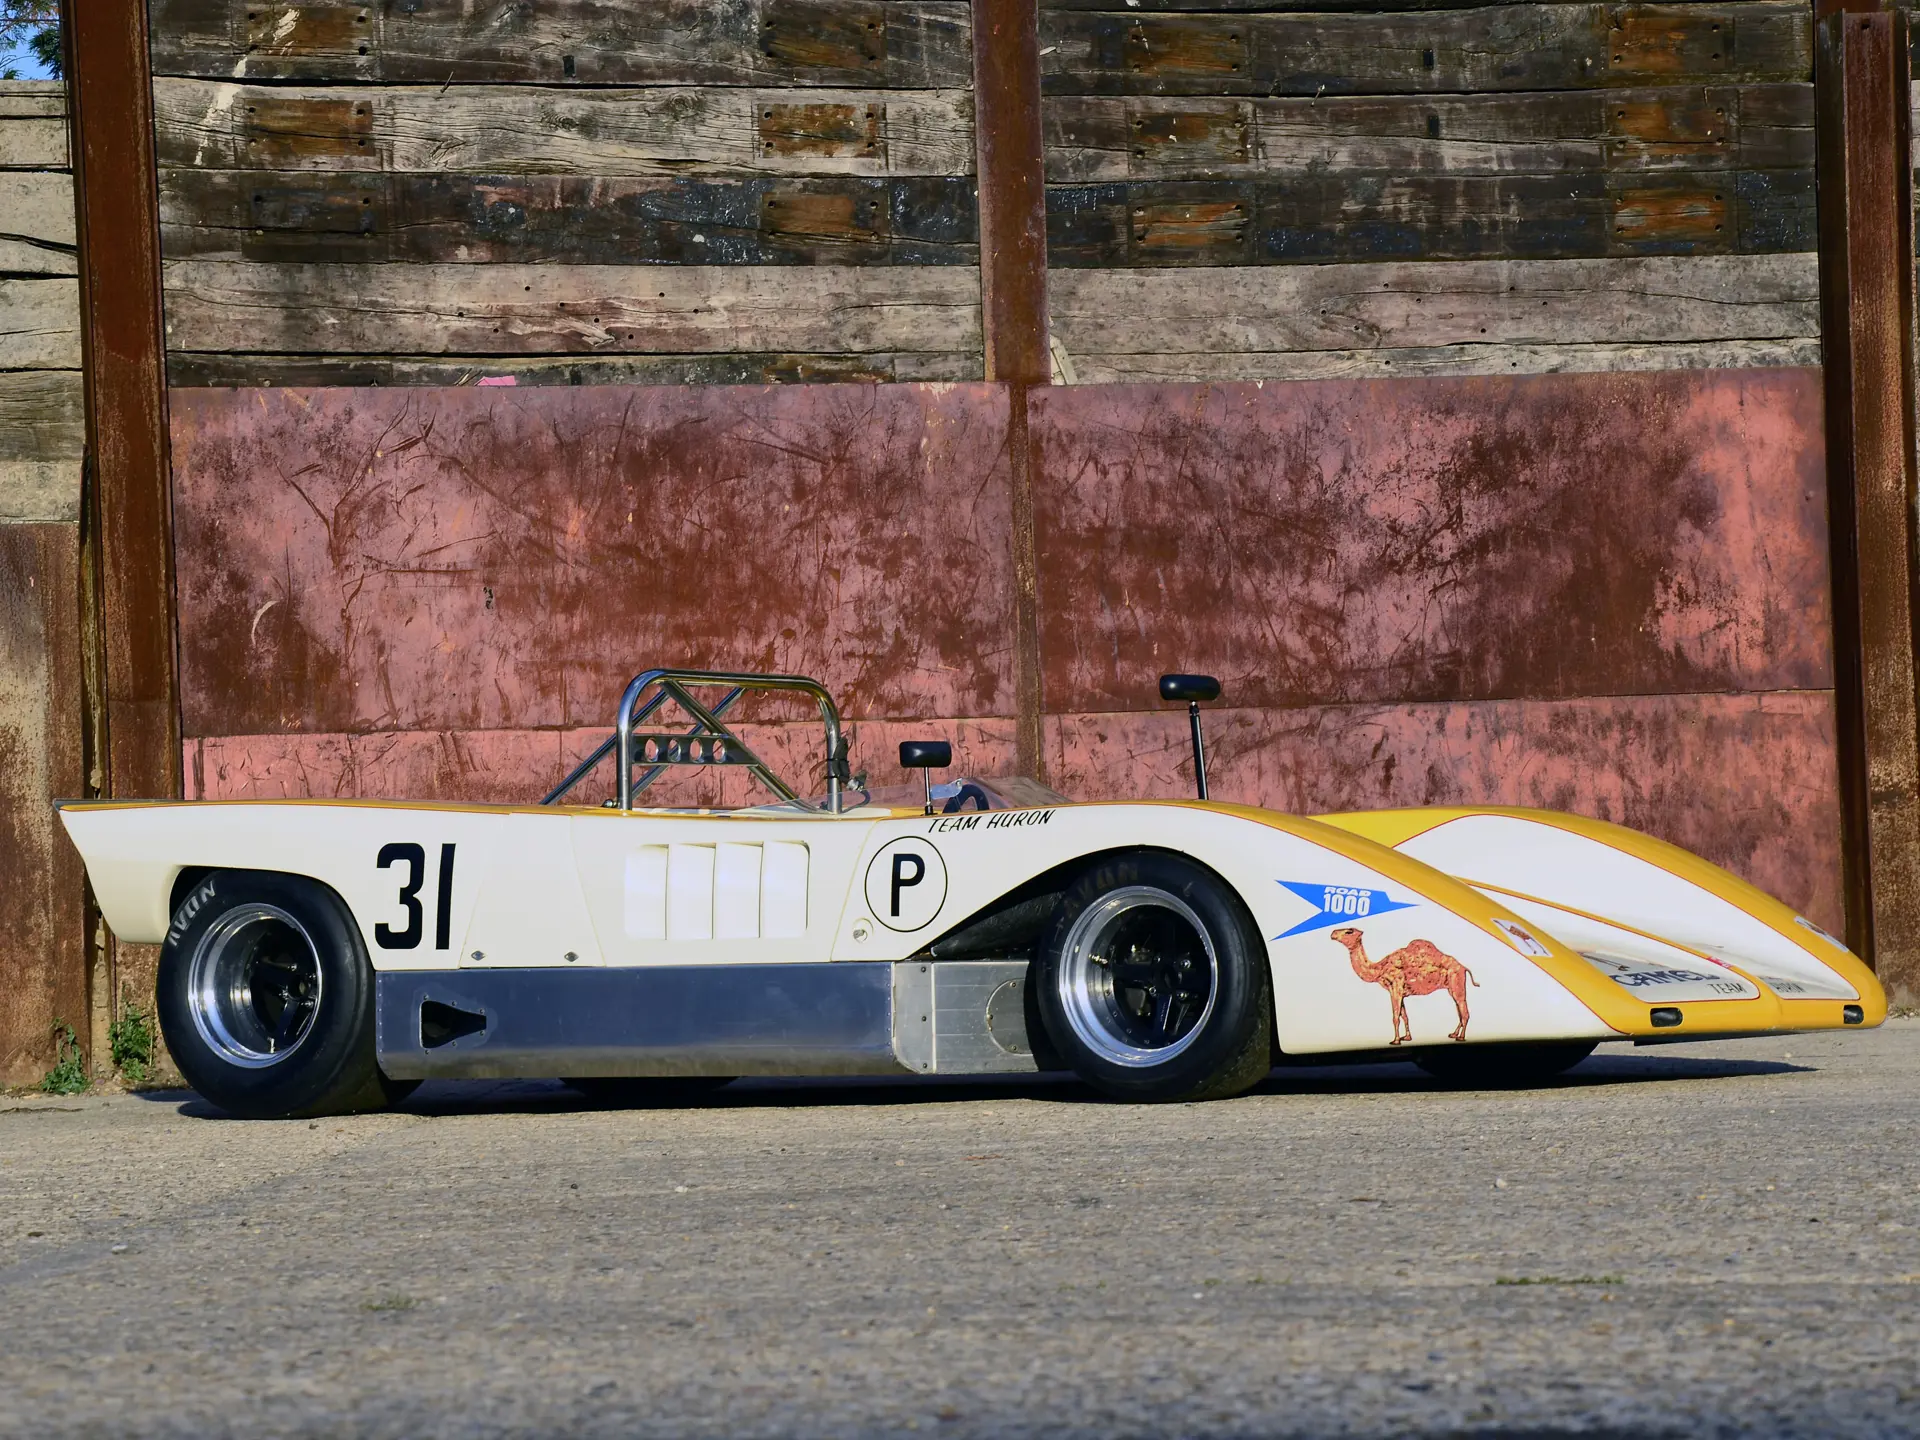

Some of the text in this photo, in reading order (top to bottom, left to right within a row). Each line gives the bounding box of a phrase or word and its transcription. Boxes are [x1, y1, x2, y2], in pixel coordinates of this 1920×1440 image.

[928, 809, 1056, 833] TEAM HURON
[375, 842, 456, 949] 31
[891, 854, 925, 916] P
[1324, 886, 1372, 897] ROAD
[167, 880, 216, 947] AVON
[1323, 893, 1371, 916] 1000
[1609, 969, 1720, 987] CAMEL
[1708, 983, 1748, 995] TEAM
